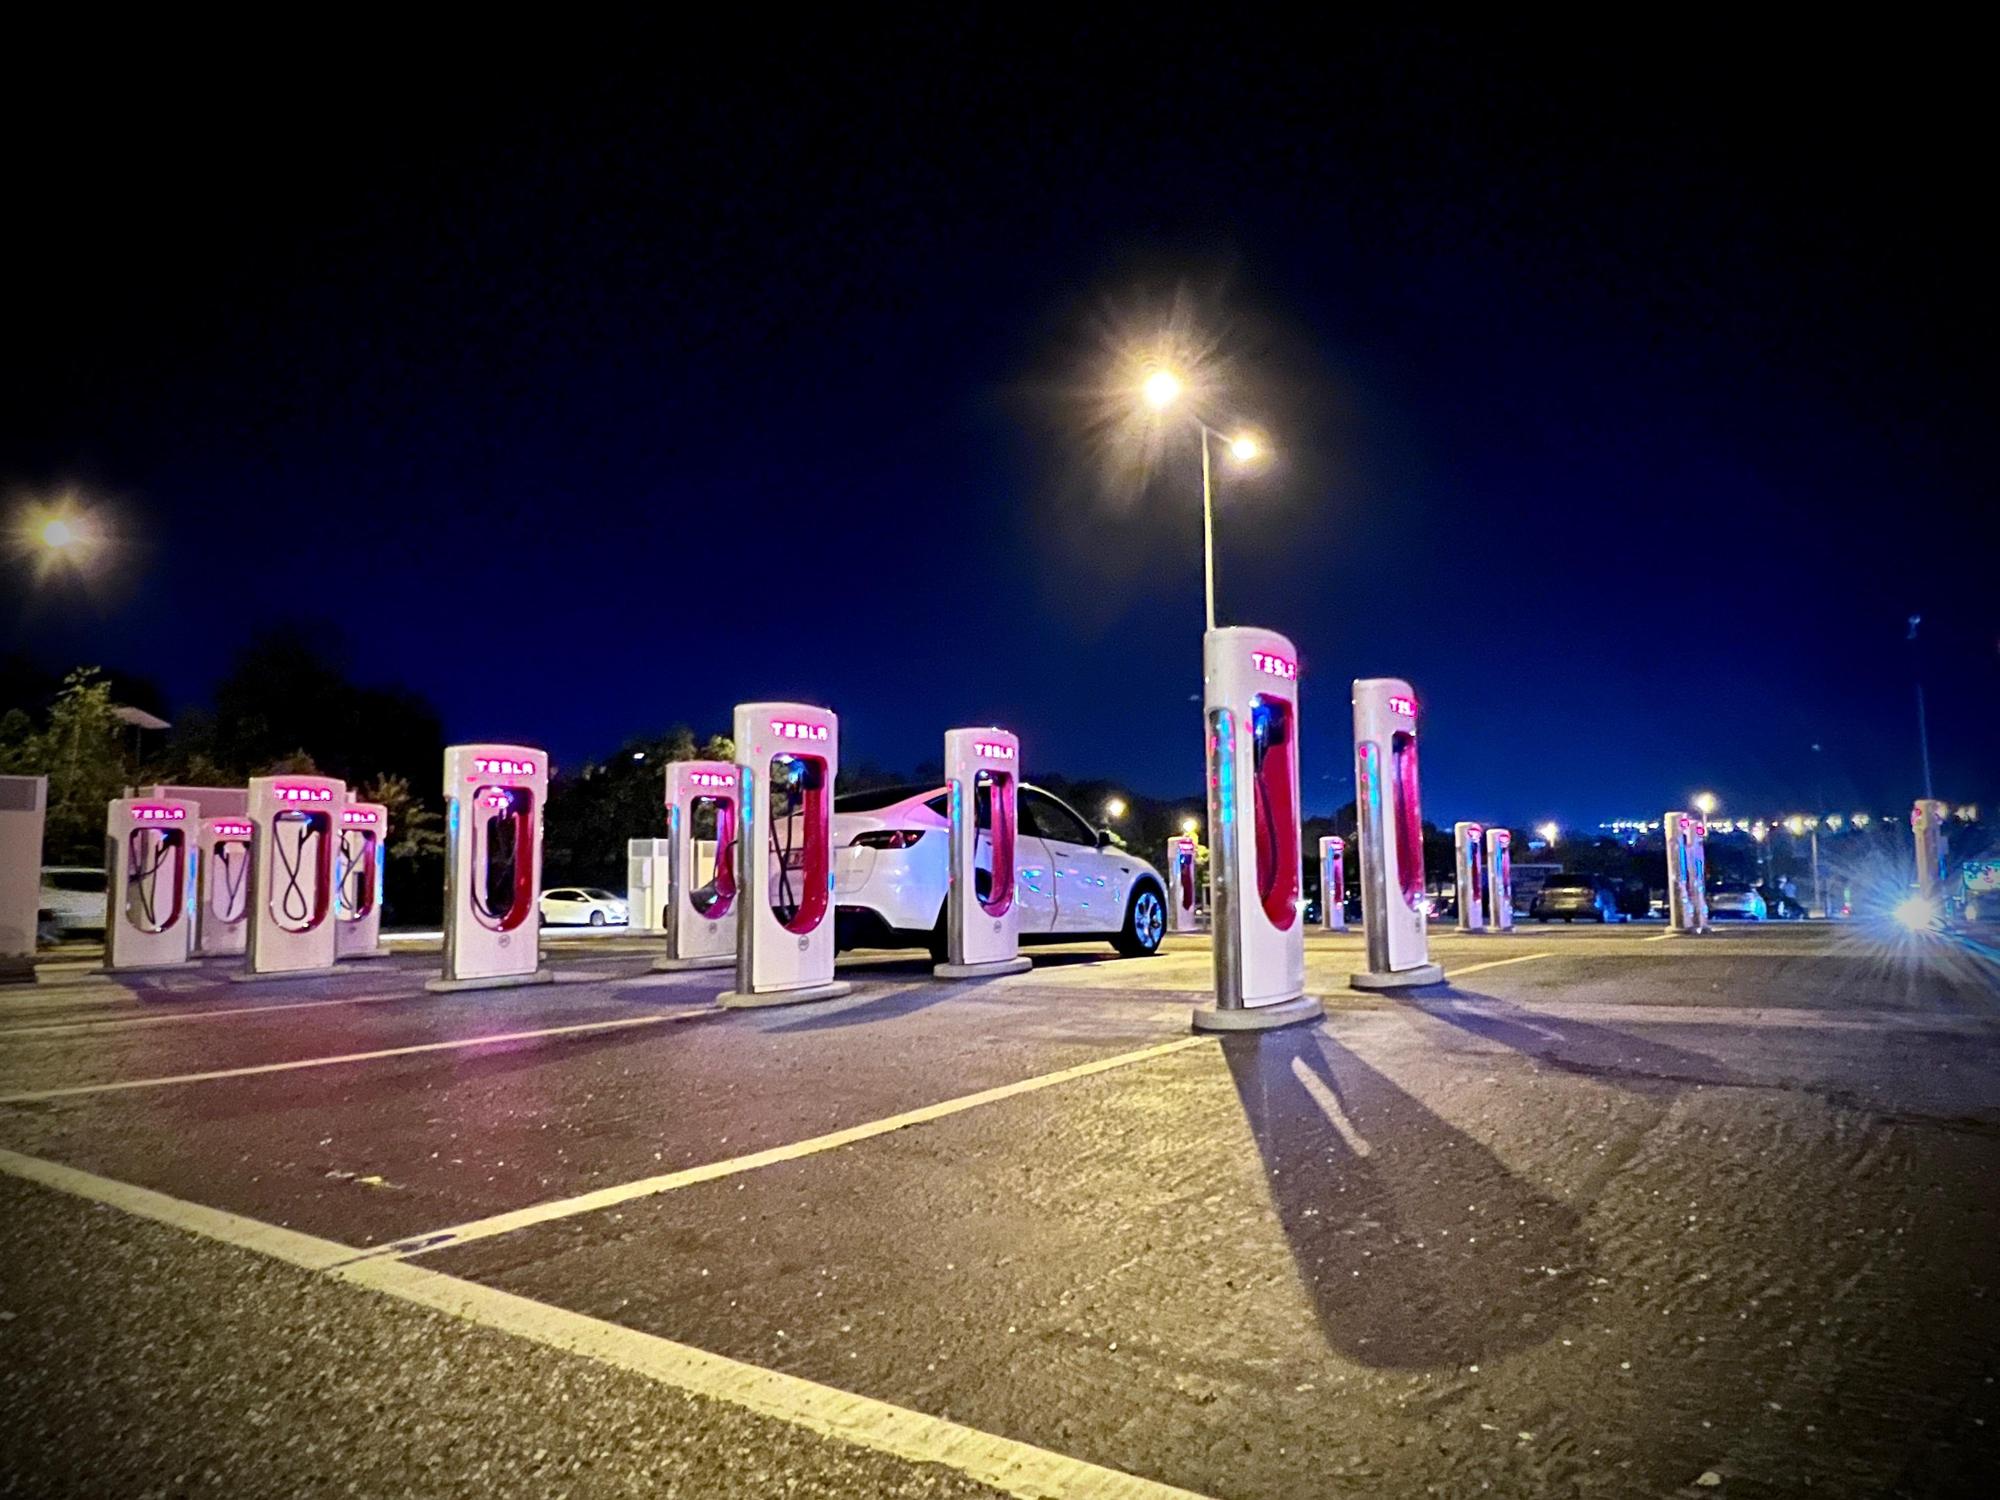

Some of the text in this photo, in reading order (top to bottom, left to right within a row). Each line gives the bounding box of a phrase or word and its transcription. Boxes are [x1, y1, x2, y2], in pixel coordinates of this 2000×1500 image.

[1389, 698, 1416, 717] TESL
[771, 722, 828, 740] TESLA
[973, 743, 1013, 759] TESLA
[474, 760, 534, 774] TESLA
[690, 774, 735, 786] TESLA
[275, 789, 331, 801] TESLA
[131, 809, 184, 819] TESLA
[342, 813, 377, 823] ESLA
